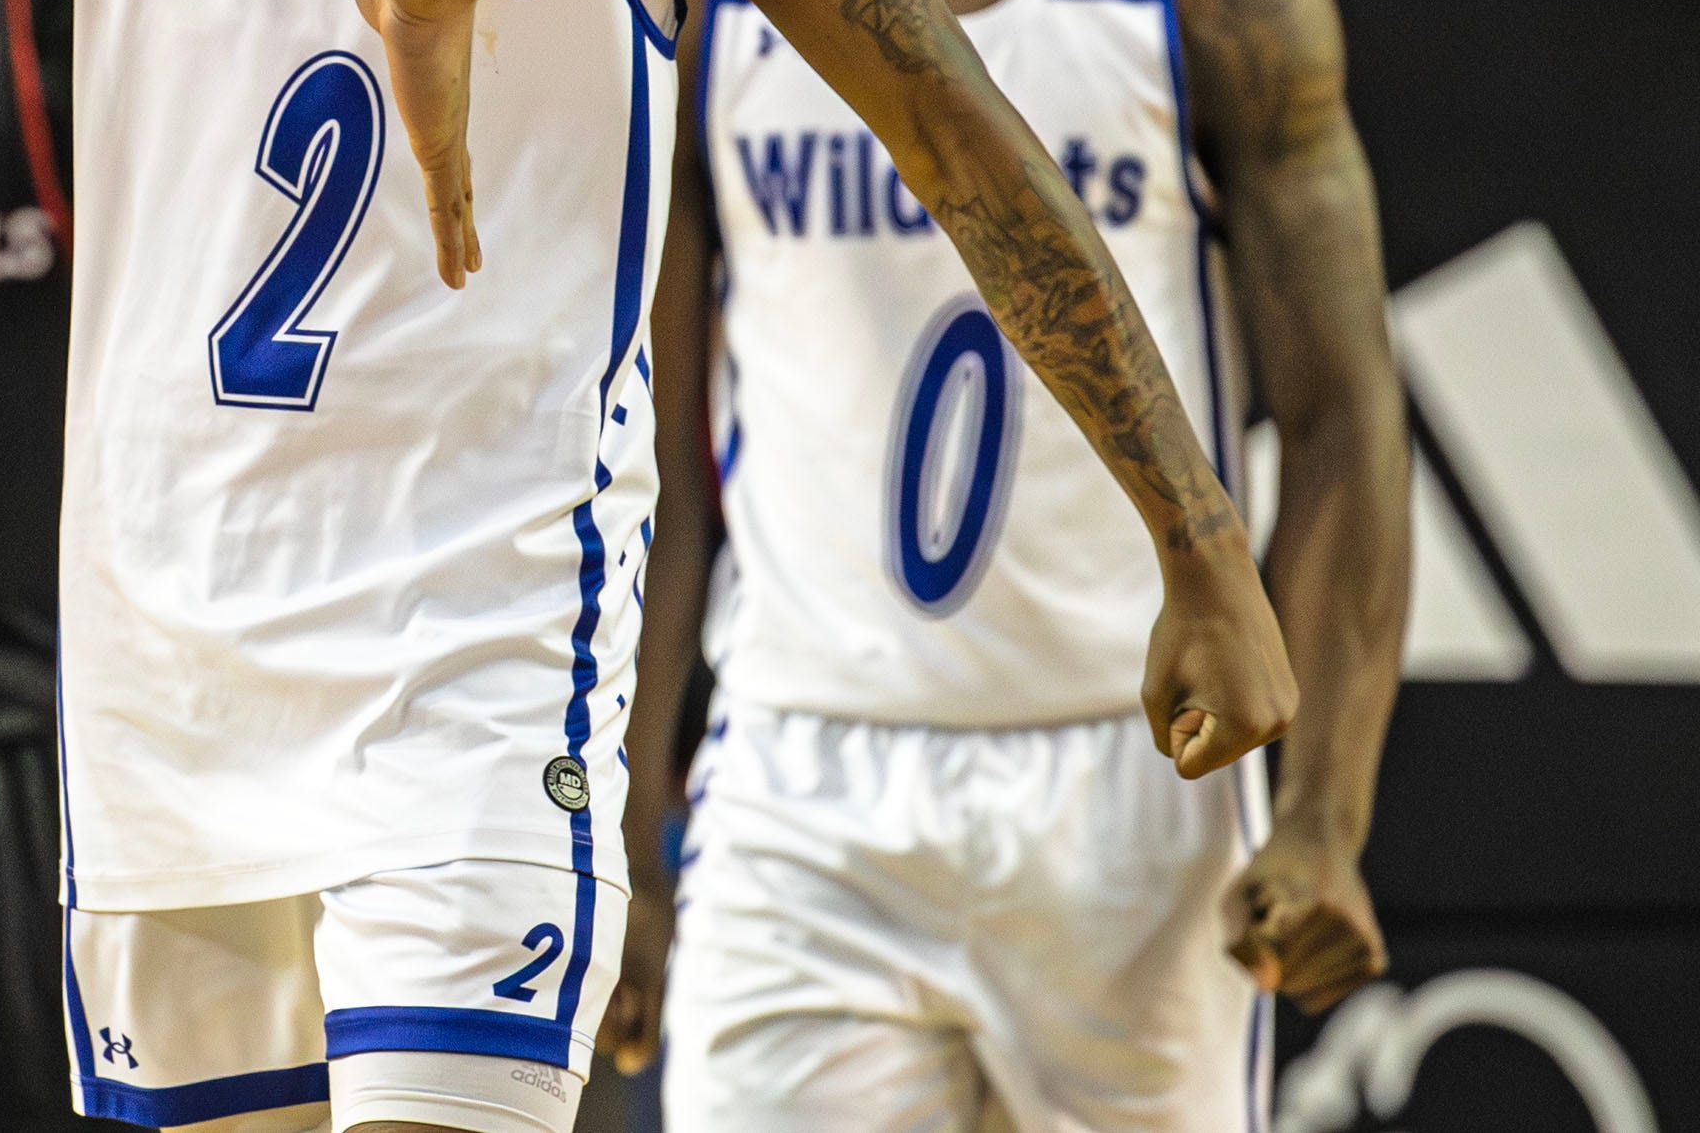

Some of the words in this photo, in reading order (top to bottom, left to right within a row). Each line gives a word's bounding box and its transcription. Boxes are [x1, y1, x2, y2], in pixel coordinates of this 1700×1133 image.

[208, 50, 386, 412] 2
[881, 291, 1026, 621] 0
[559, 771, 582, 789] MD
[492, 922, 565, 1003] 2
[510, 1069, 567, 1104] adidas
